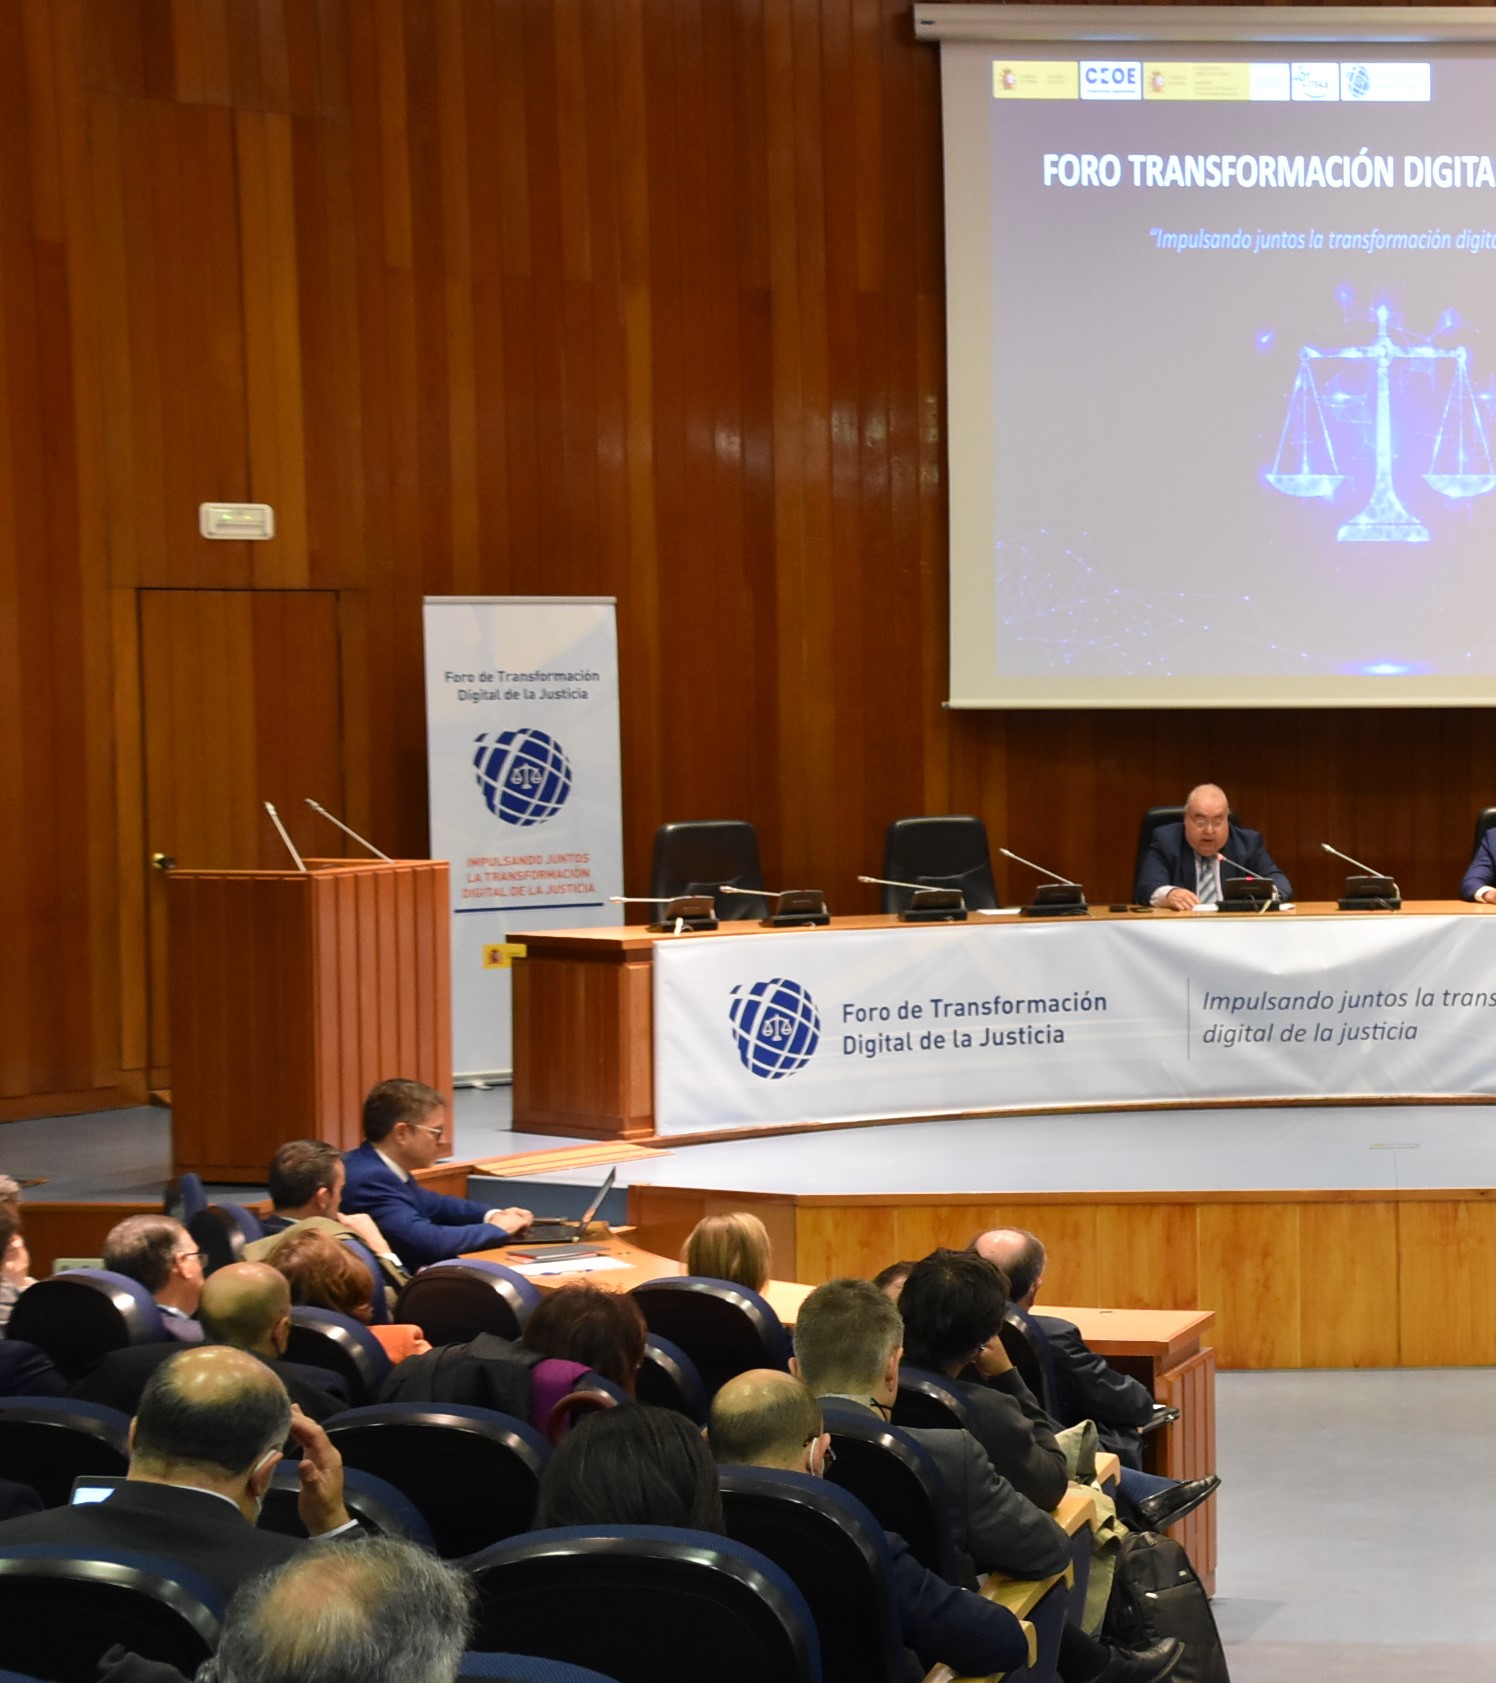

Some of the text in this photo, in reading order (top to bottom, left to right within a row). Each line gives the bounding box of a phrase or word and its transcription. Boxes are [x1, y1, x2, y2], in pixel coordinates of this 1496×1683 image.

[1043, 153, 1122, 187] FORO
[1128, 147, 1395, 188] TRANSFORMACIÓN
[1253, 229, 1305, 253] juntos
[1309, 228, 1324, 249] la
[1328, 228, 1451, 254] transformación
[444, 669, 600, 683] Foro de Transformación
[457, 687, 589, 703] Digital de la Justicia
[467, 853, 590, 867] IMPULSANDO JUNTOS
[463, 884, 596, 898] DIGITAL DE LA JUSTICIA
[467, 873, 482, 883] LA
[843, 990, 1107, 1023] Foro de Transformación
[1203, 990, 1334, 1014] Impulsando
[1337, 990, 1409, 1014] juntos
[1415, 987, 1435, 1007] la
[843, 1024, 1065, 1058] Digital de la Justicia
[1203, 1021, 1418, 1048] digital de la justicia
